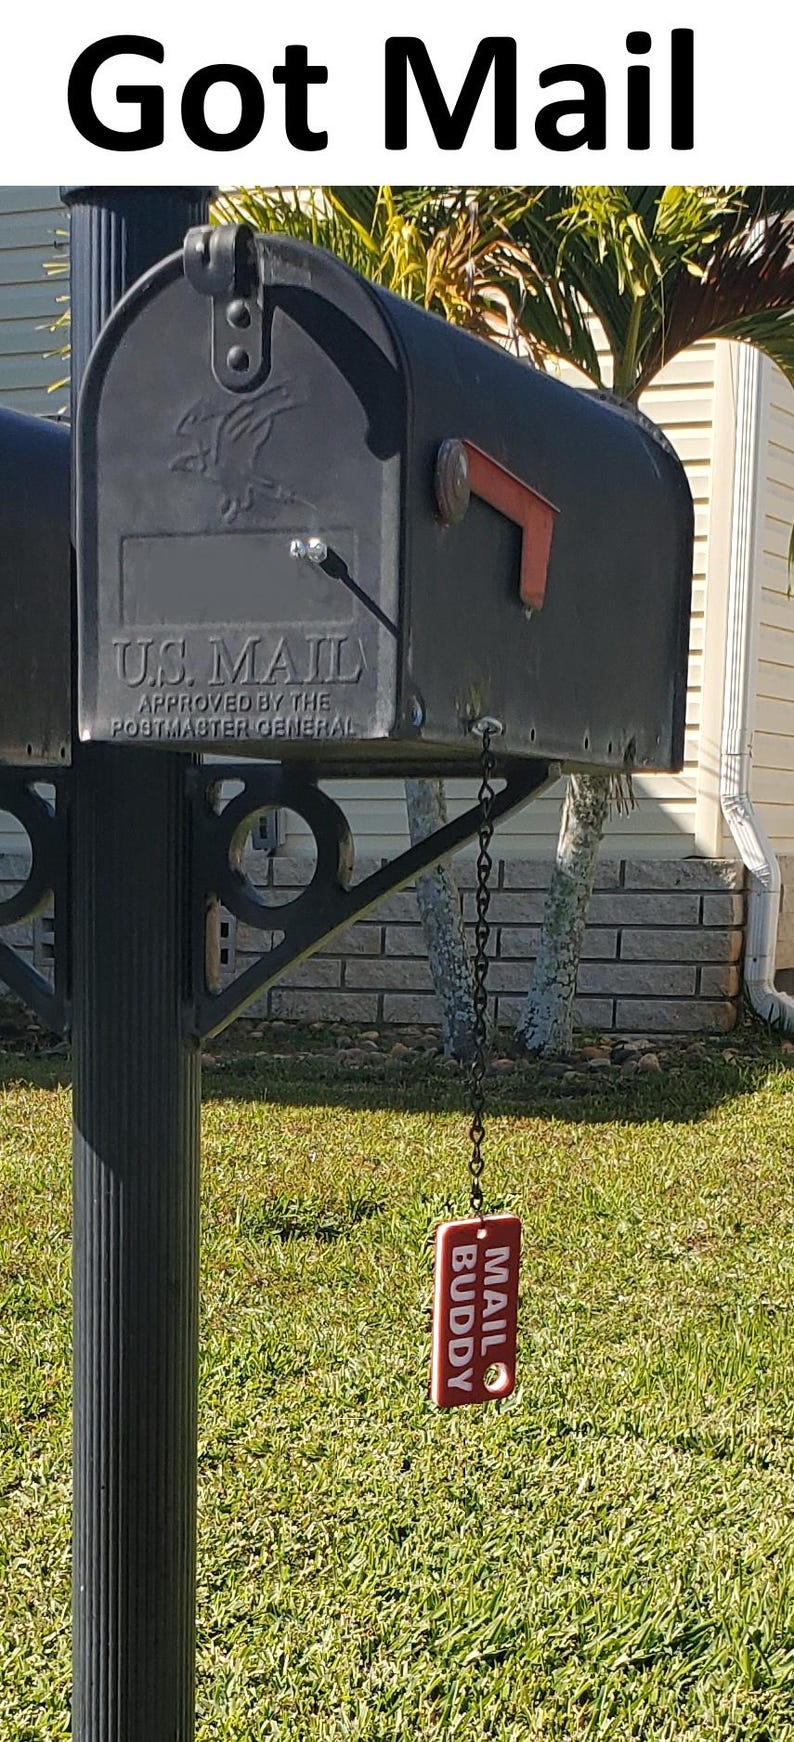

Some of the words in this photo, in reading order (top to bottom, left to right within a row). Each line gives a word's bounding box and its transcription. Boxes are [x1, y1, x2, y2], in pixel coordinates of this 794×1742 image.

[112, 637, 194, 688] U.S.
[209, 635, 363, 687] MAIL
[111, 718, 250, 739] POSTMASTER
[254, 715, 356, 737] GENERAL
[139, 694, 252, 713] APPROVED
[257, 693, 282, 712] BY
[290, 692, 331, 712] THE
[447, 1244, 478, 1392] BUDDY
[481, 1246, 510, 1357] MAIL
